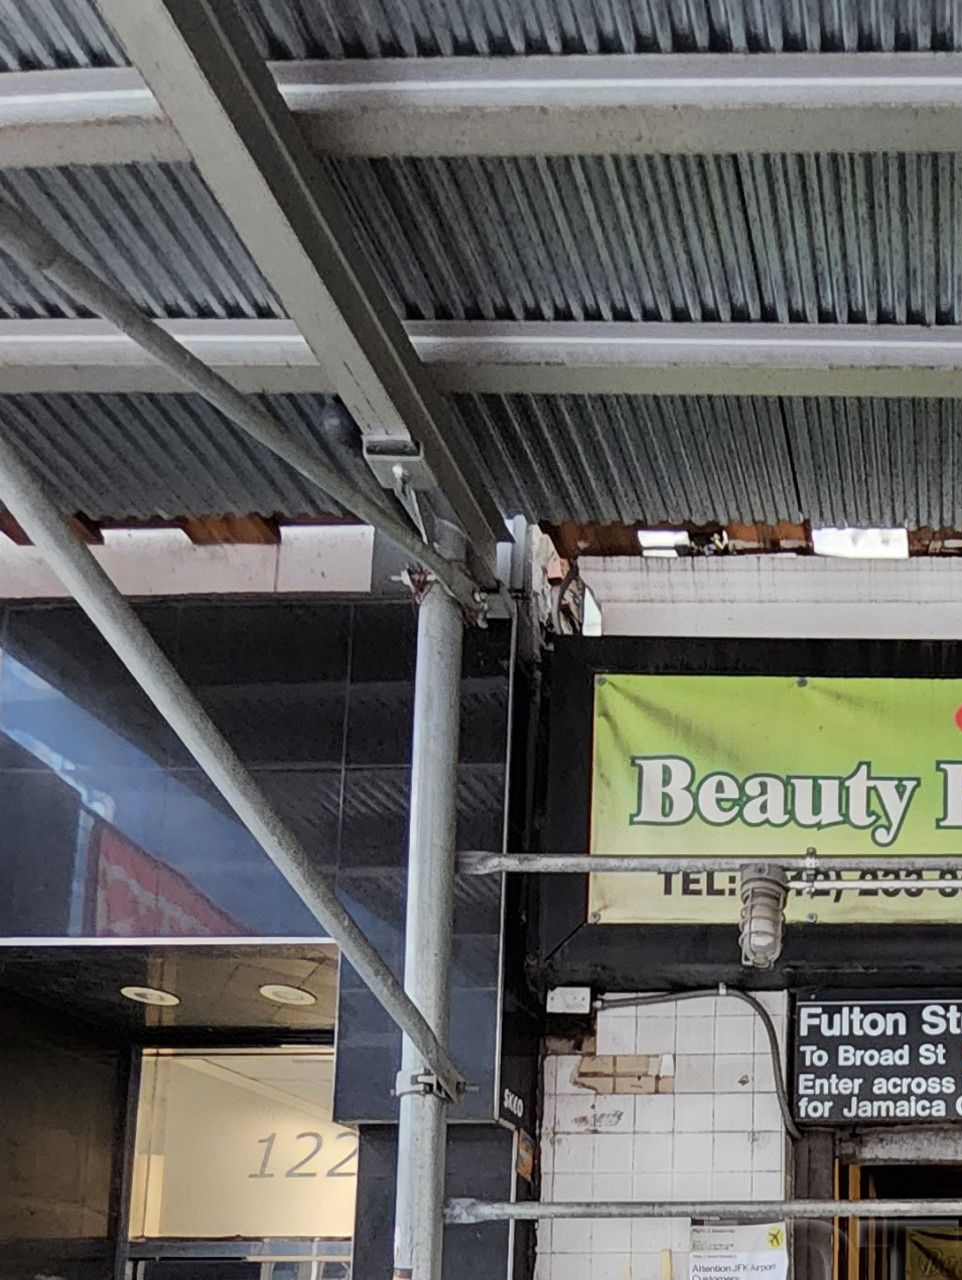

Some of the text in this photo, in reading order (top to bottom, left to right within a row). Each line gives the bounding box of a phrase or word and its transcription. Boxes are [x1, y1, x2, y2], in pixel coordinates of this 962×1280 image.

[630, 754, 920, 846] Beauty
[657, 869, 737, 897] TEL:
[799, 1005, 907, 1036] Fulton
[799, 1045, 829, 1067] To
[837, 1044, 910, 1067] Broad
[918, 1043, 946, 1066] St
[799, 1073, 863, 1095] Enter
[872, 1077, 956, 1094] across
[798, 1096, 833, 1118] for
[842, 1096, 946, 1118] Jamaica
[247, 1131, 359, 1180] 122
[691, 1262, 777, 1274] Attention JFK Airport
